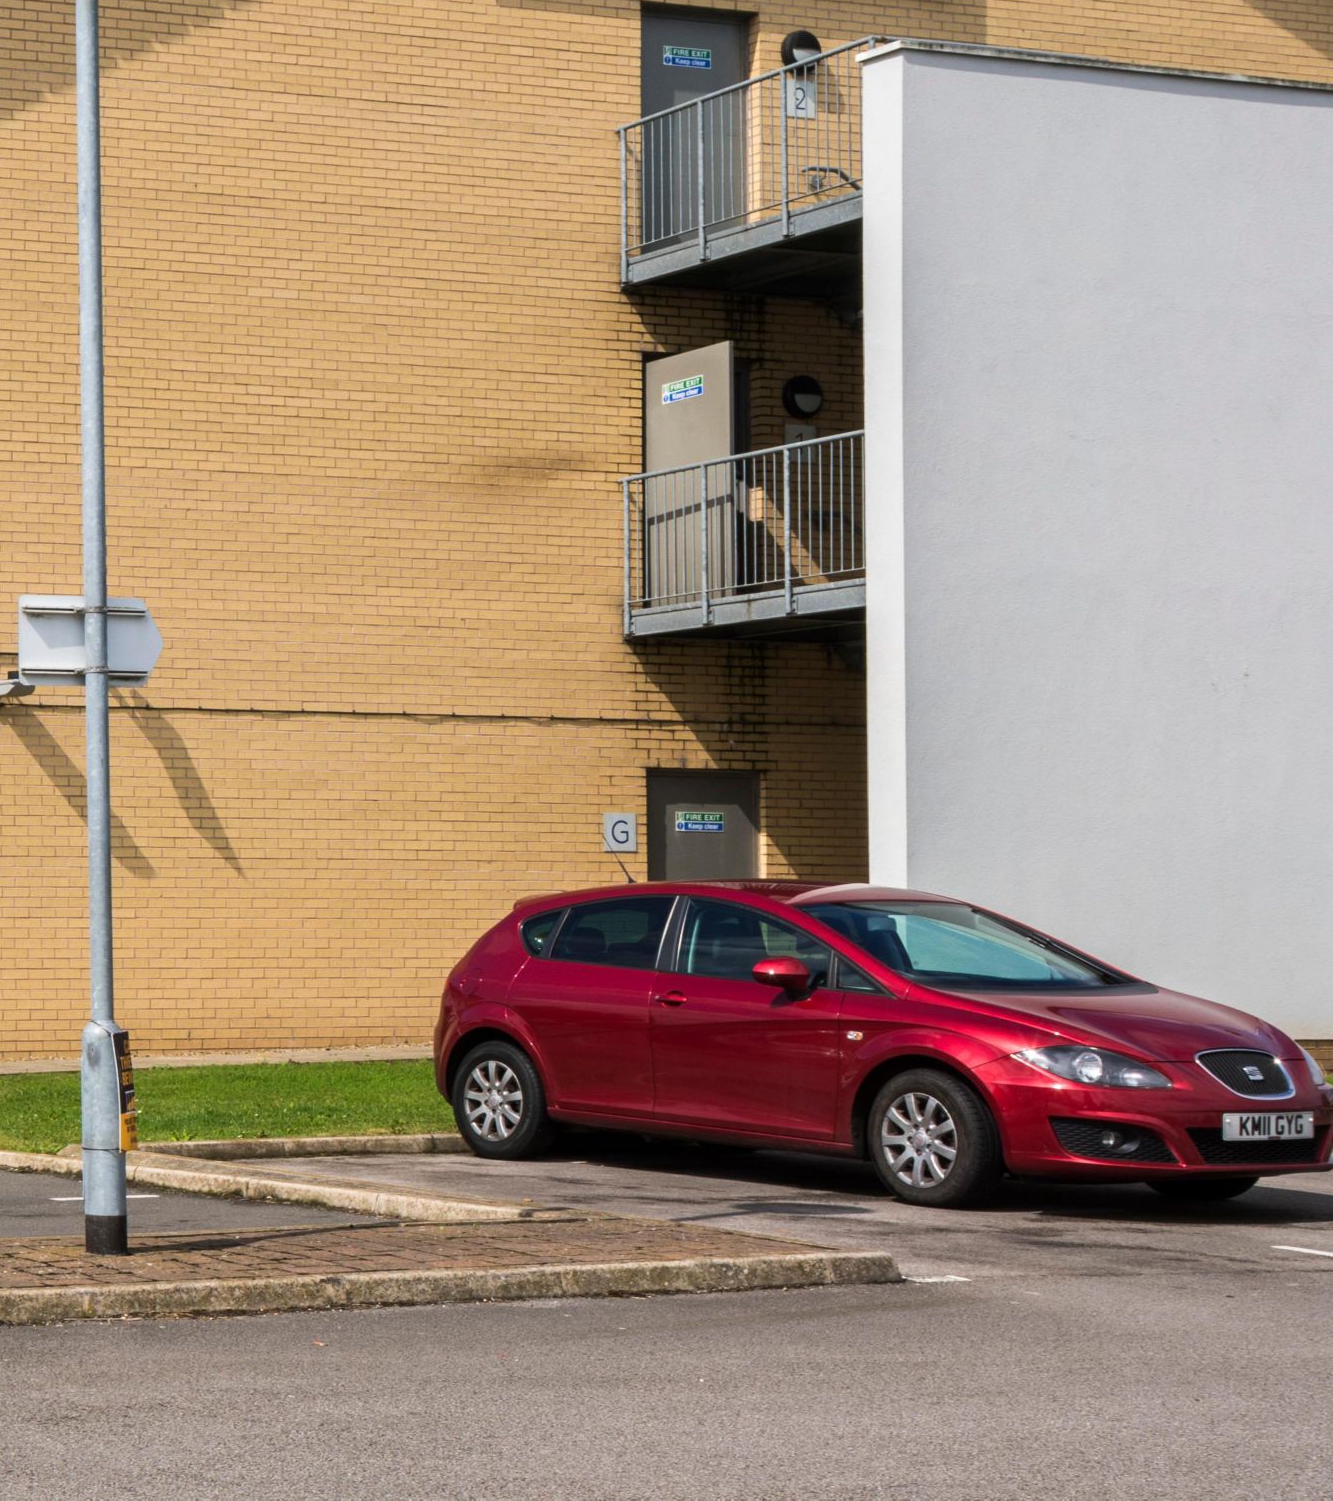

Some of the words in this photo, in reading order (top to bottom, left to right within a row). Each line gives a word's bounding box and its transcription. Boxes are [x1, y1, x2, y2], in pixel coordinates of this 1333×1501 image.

[674, 48, 691, 57] FIRE
[691, 50, 708, 58] EXIT
[795, 86, 806, 110] 2
[685, 813, 703, 821] FIRE
[611, 820, 630, 844] G
[687, 822, 703, 830] Keep
[1275, 1114, 1304, 1135] GYG
